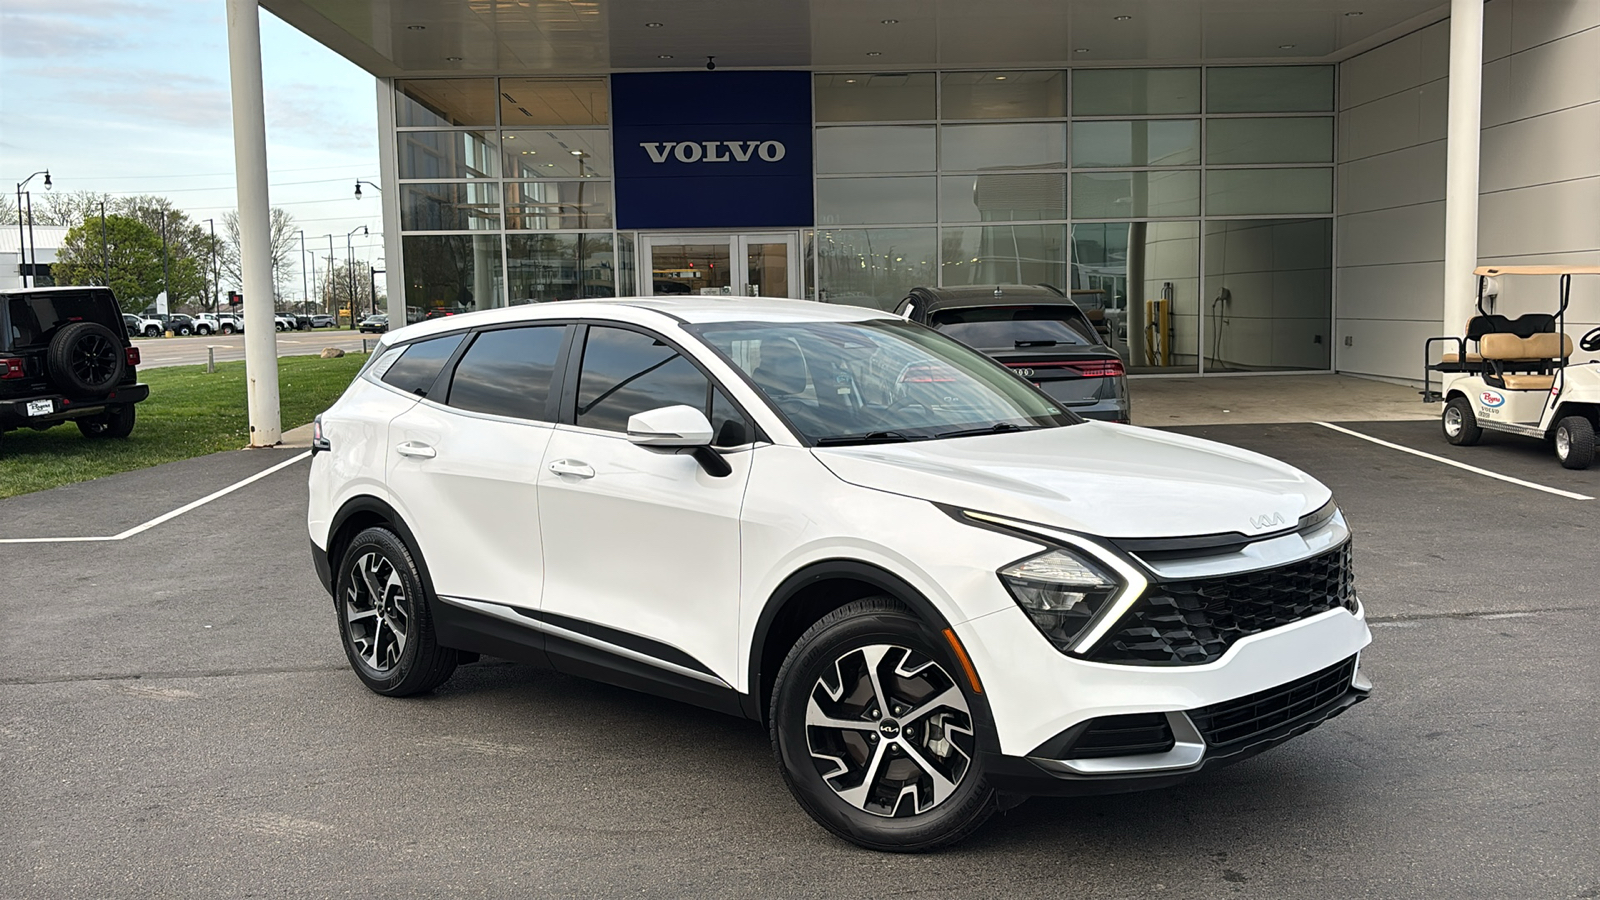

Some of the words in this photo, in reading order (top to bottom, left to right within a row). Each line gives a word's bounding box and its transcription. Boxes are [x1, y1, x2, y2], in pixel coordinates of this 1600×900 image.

[639, 141, 786, 163] VOLVO
[1249, 512, 1285, 529] KIA
[880, 725, 899, 733] KIA
